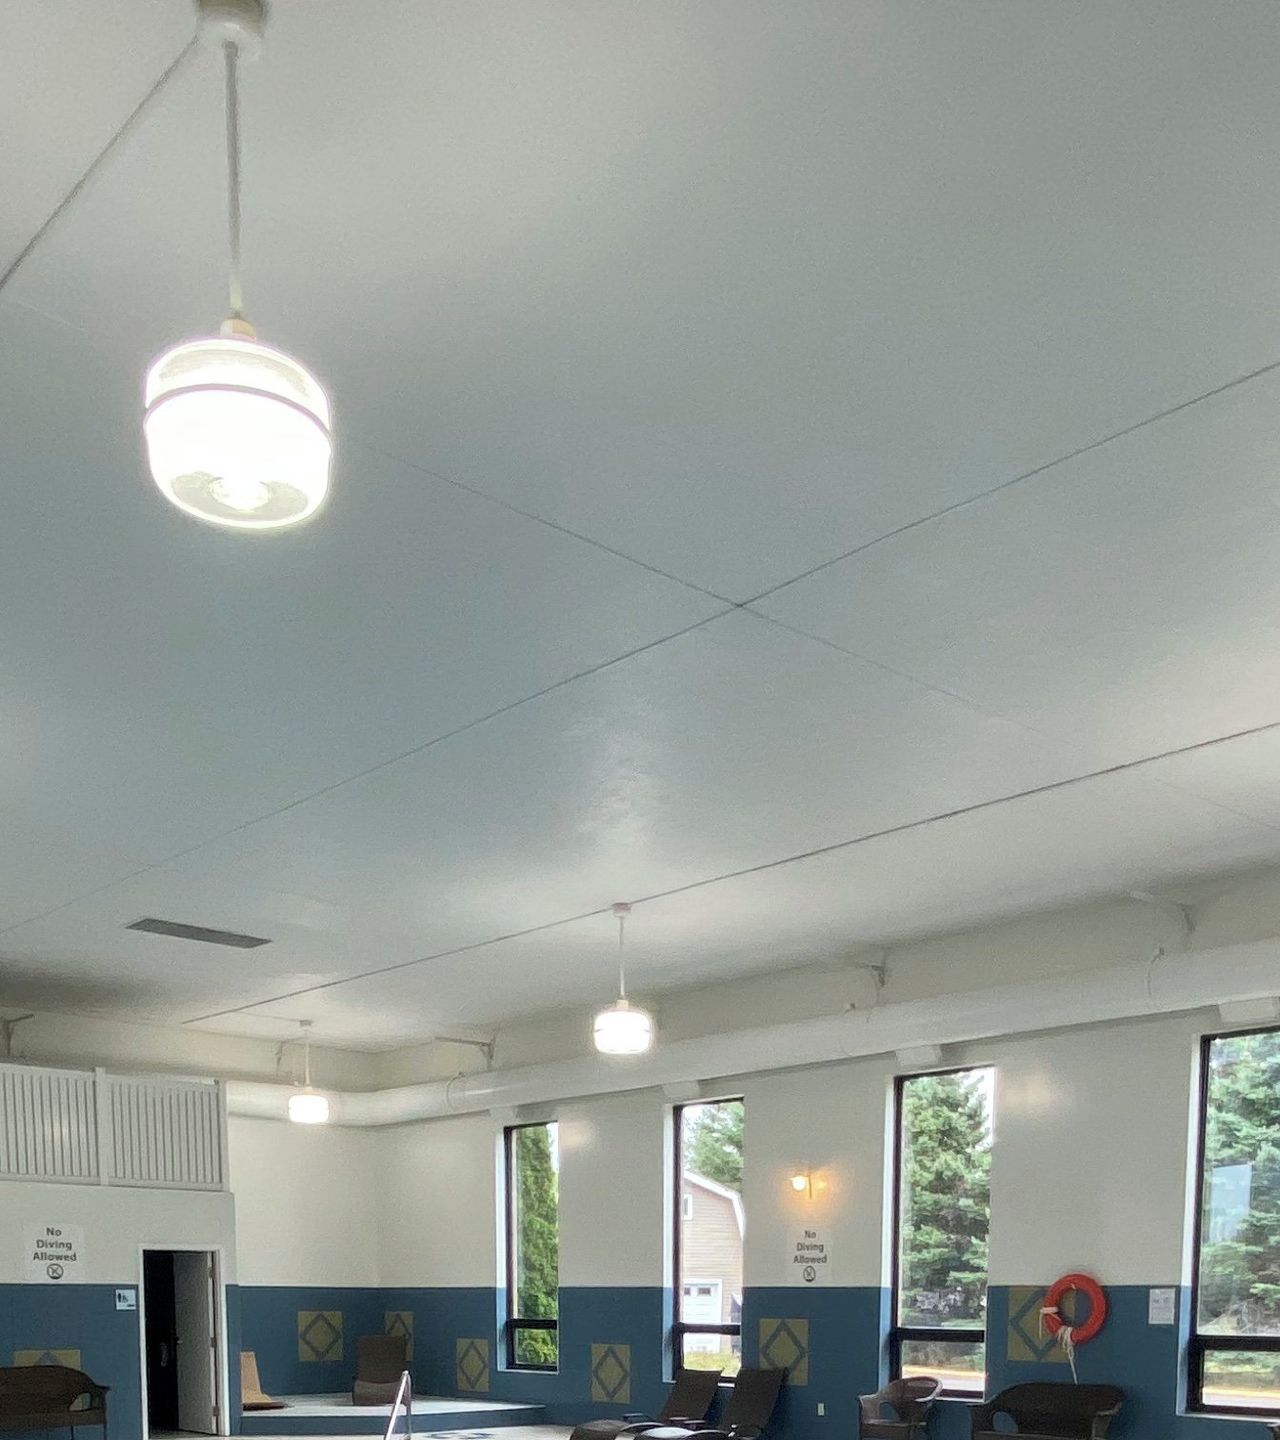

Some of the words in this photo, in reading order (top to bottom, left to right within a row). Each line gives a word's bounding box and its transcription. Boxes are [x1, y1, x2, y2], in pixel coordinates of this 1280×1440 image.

[46, 1227, 62, 1237] No
[804, 1230, 817, 1239] No
[36, 1239, 73, 1251] Diving
[796, 1242, 825, 1253] Diving
[32, 1252, 77, 1262] Allowed
[792, 1254, 828, 1264] Allowed
